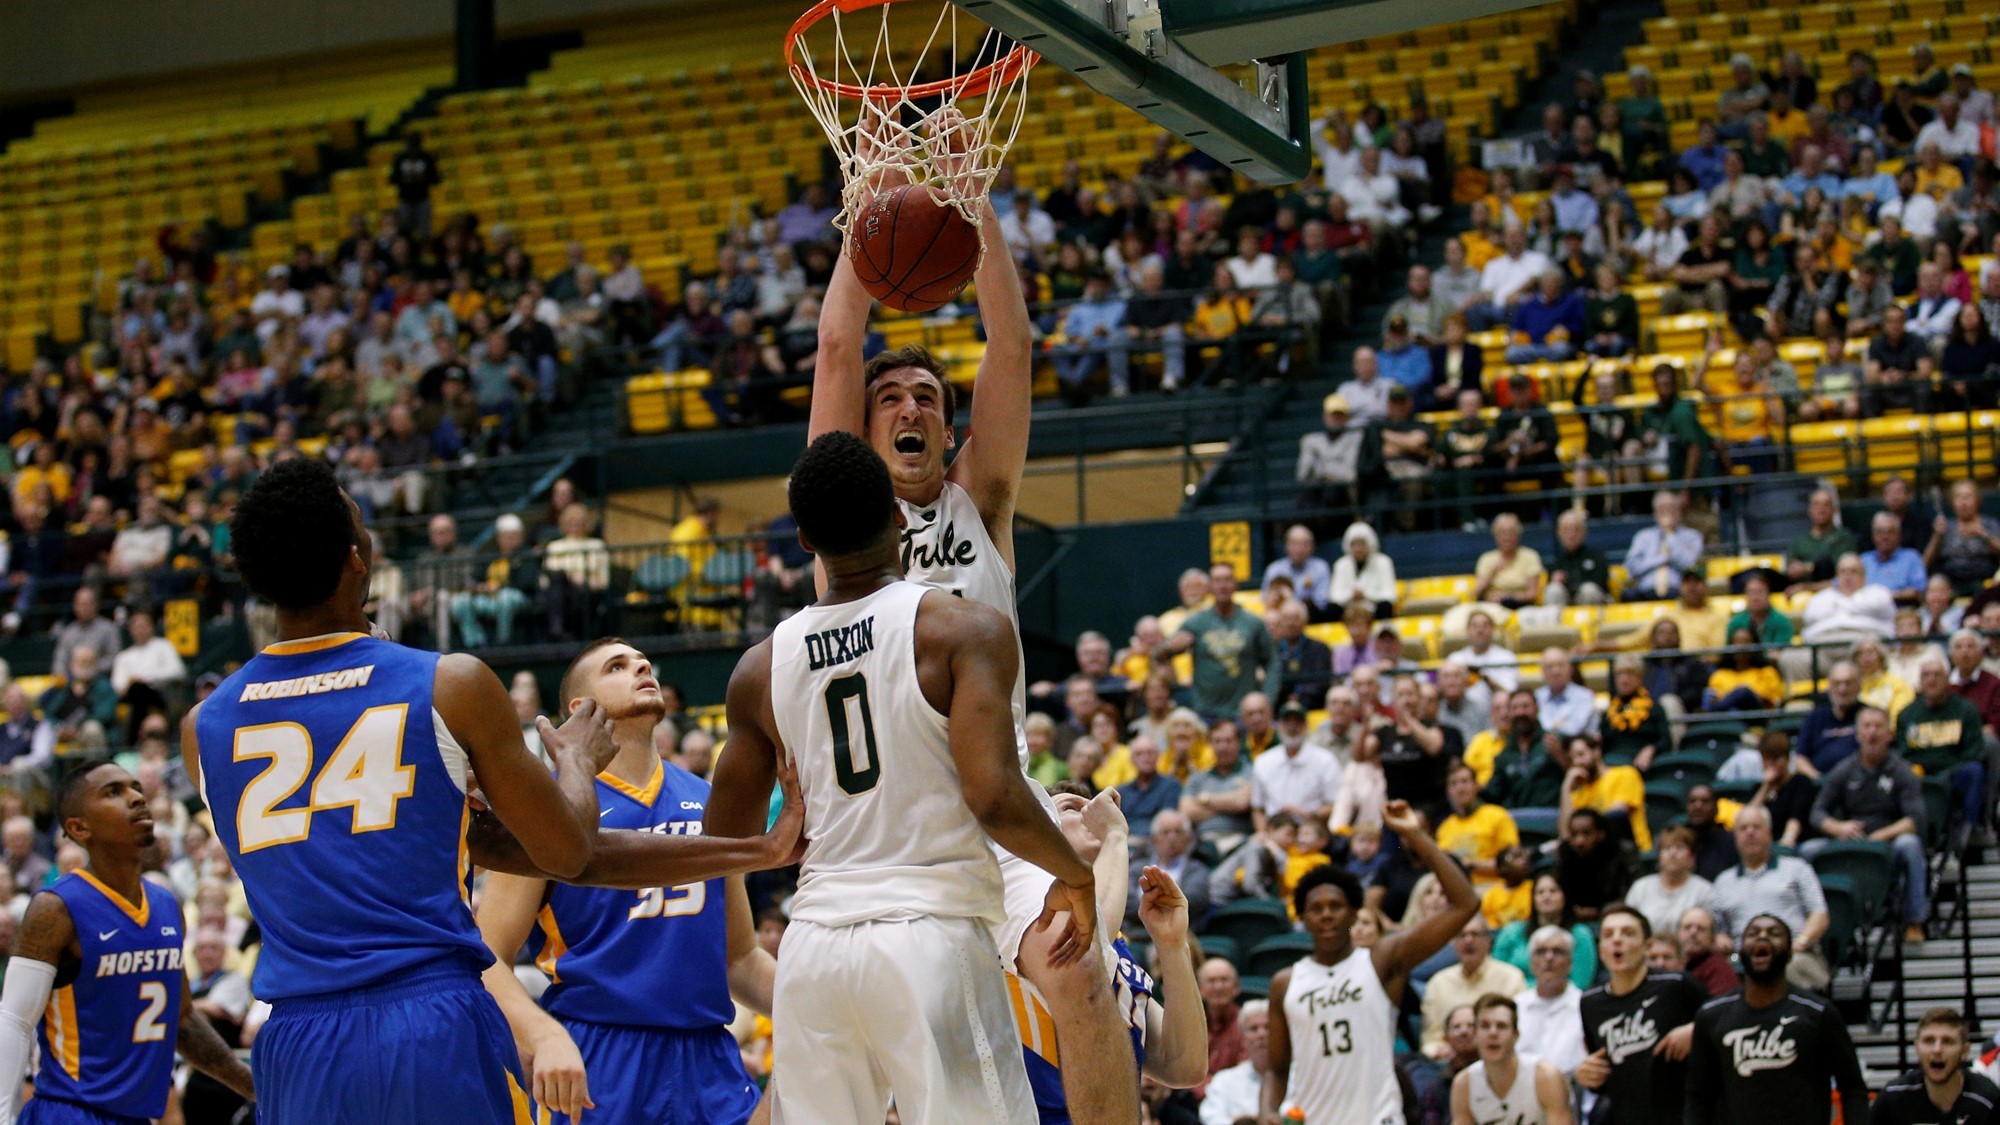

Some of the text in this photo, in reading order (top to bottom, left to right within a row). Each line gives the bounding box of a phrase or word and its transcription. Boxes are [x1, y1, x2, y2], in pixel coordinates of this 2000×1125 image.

[900, 520, 977, 575] Tribe
[805, 615, 874, 671] DIXON
[239, 665, 375, 703] ROBINSON
[823, 670, 883, 798] 0
[233, 703, 416, 855] 24
[132, 981, 168, 1043] 2
[1299, 979, 1363, 1017] Tribe
[1319, 1019, 1353, 1057] 13
[1598, 1008, 1660, 1065] Tribe
[1722, 1024, 1799, 1077] Tribe
